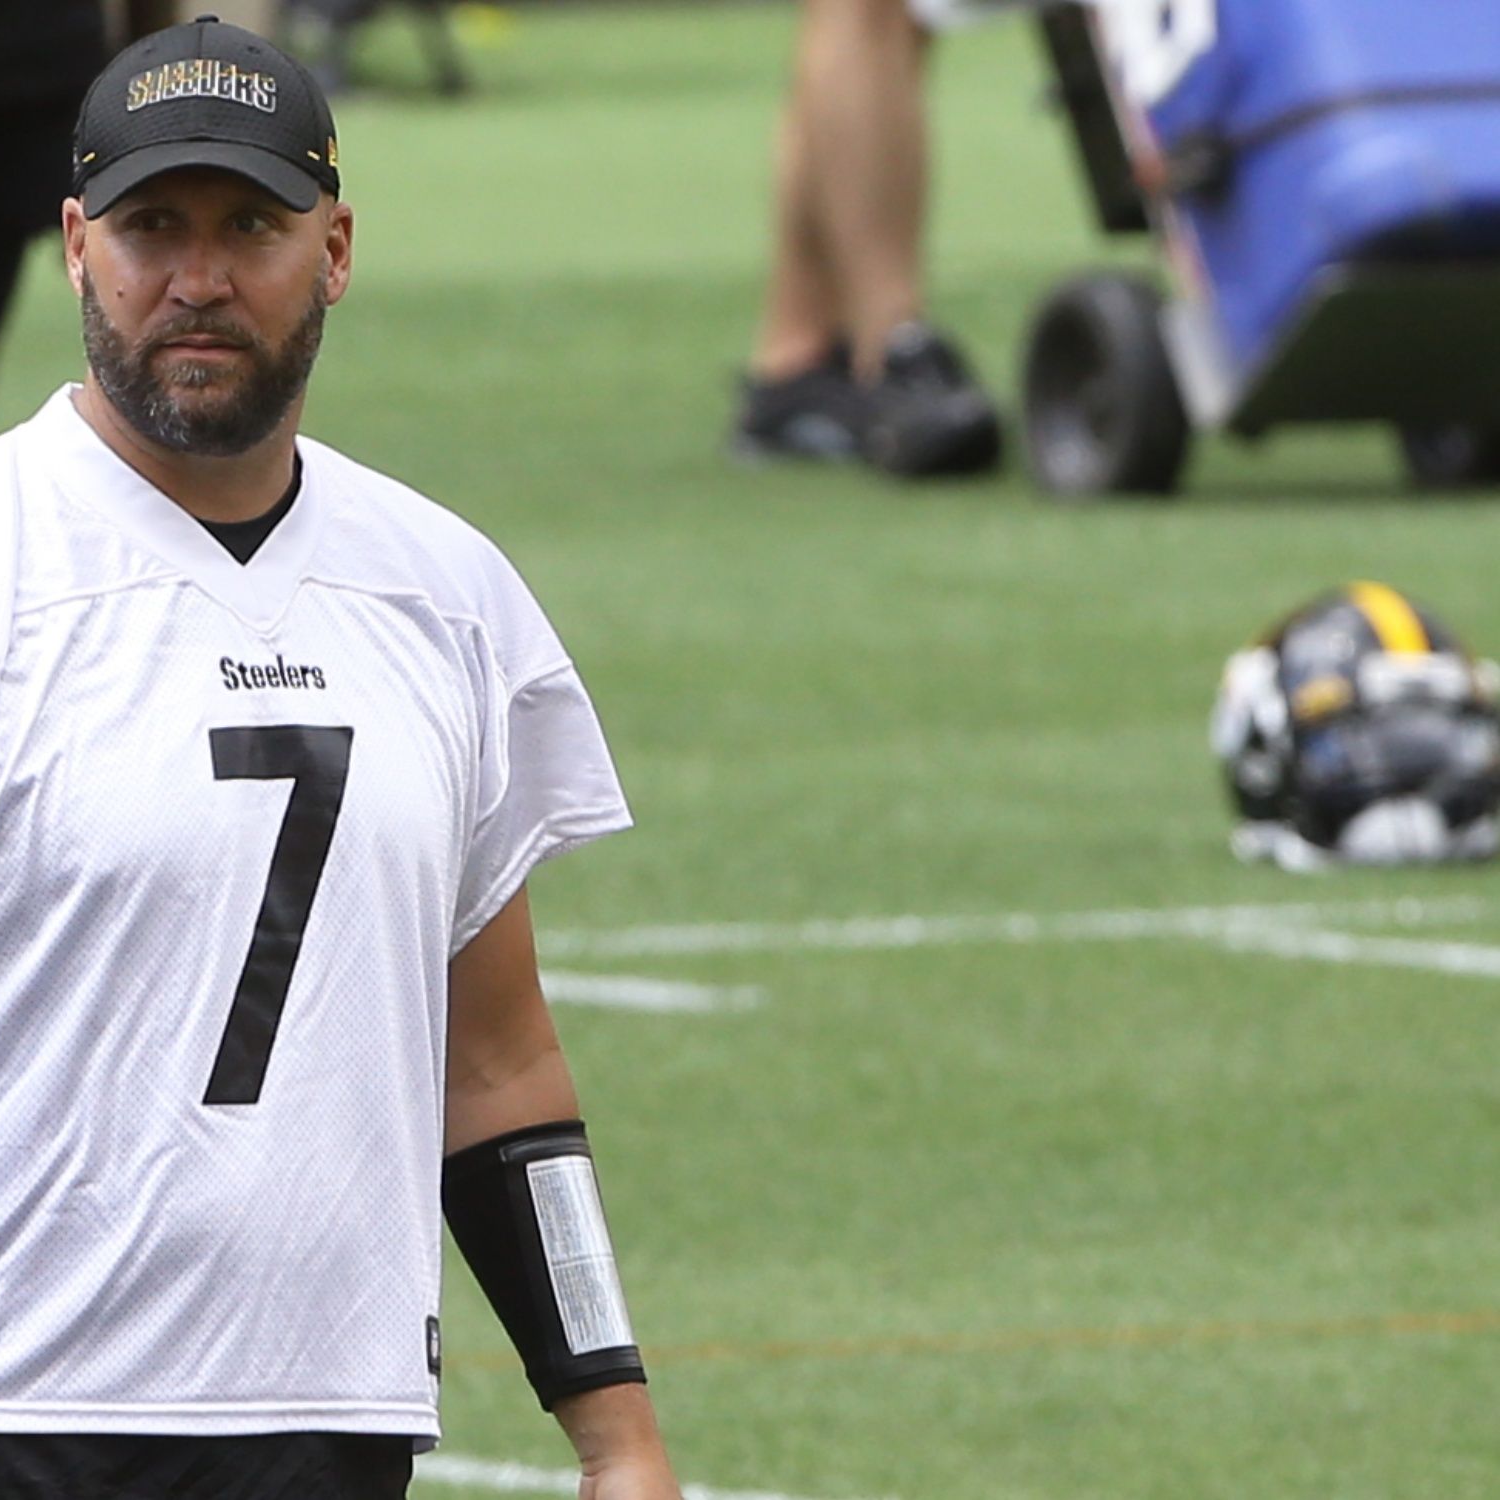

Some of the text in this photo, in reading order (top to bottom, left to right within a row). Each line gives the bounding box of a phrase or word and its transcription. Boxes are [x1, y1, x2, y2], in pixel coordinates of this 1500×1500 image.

[127, 58, 276, 113] STEELERS
[219, 653, 326, 691] Steelers
[202, 724, 354, 1106] 7
